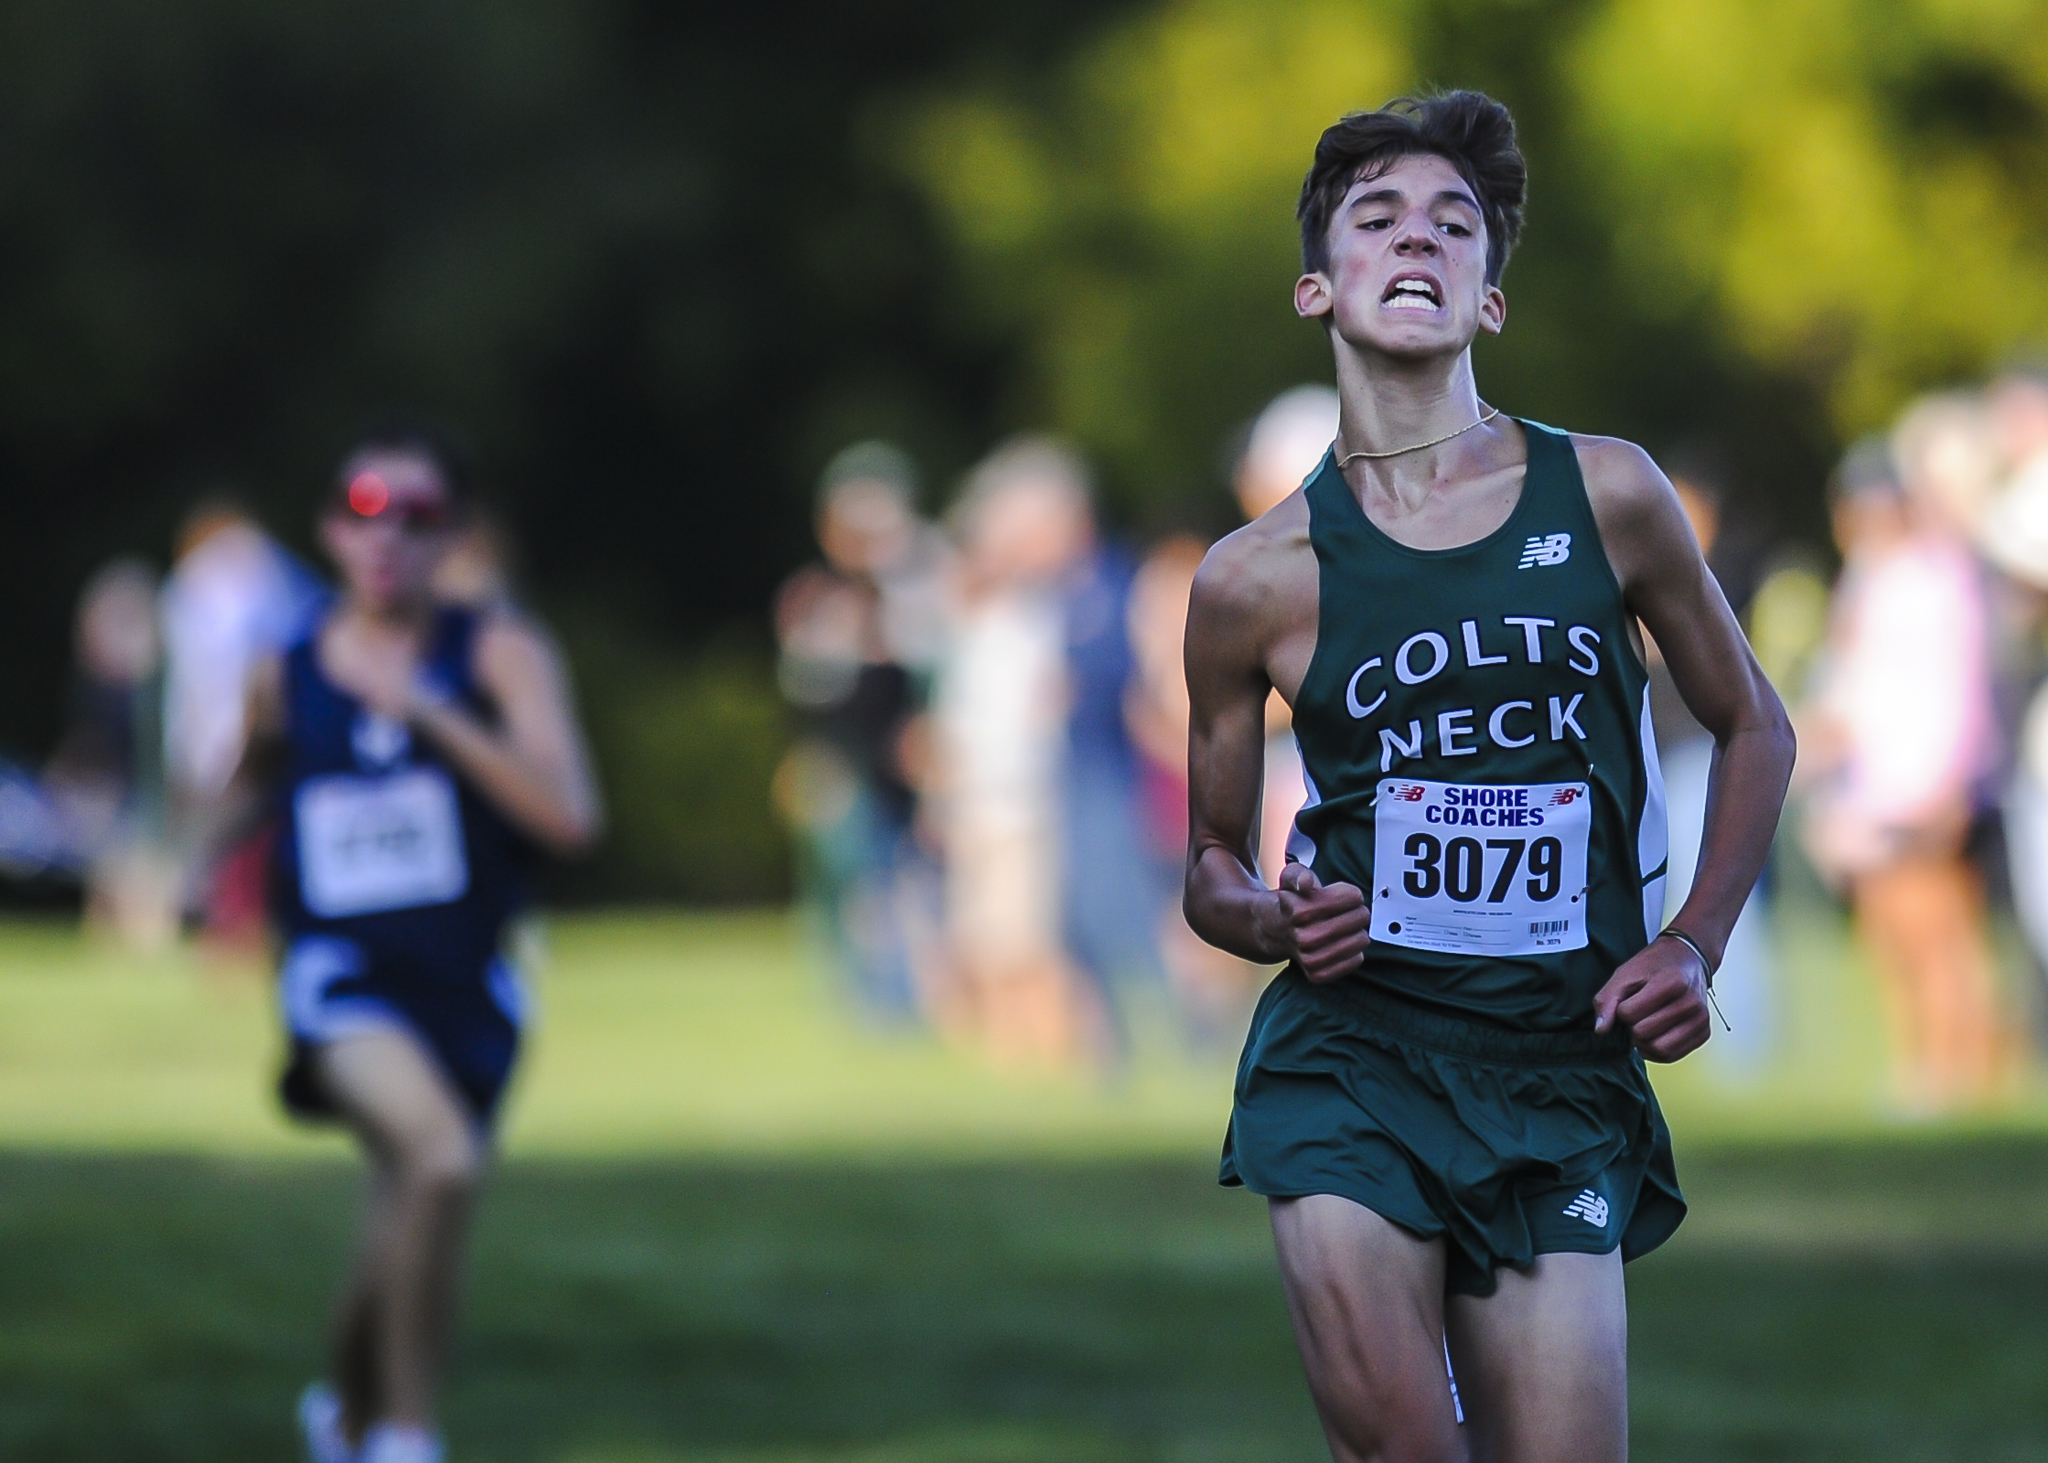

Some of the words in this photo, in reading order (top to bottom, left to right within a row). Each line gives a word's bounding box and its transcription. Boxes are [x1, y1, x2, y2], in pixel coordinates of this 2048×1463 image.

[1517, 532, 1572, 570] NB
[1345, 616, 1601, 719] COLTS
[1377, 693, 1588, 773] NECK
[1425, 805, 1545, 827] COACHES
[1443, 787, 1529, 807] SHORE
[1403, 832, 1563, 904] 3079
